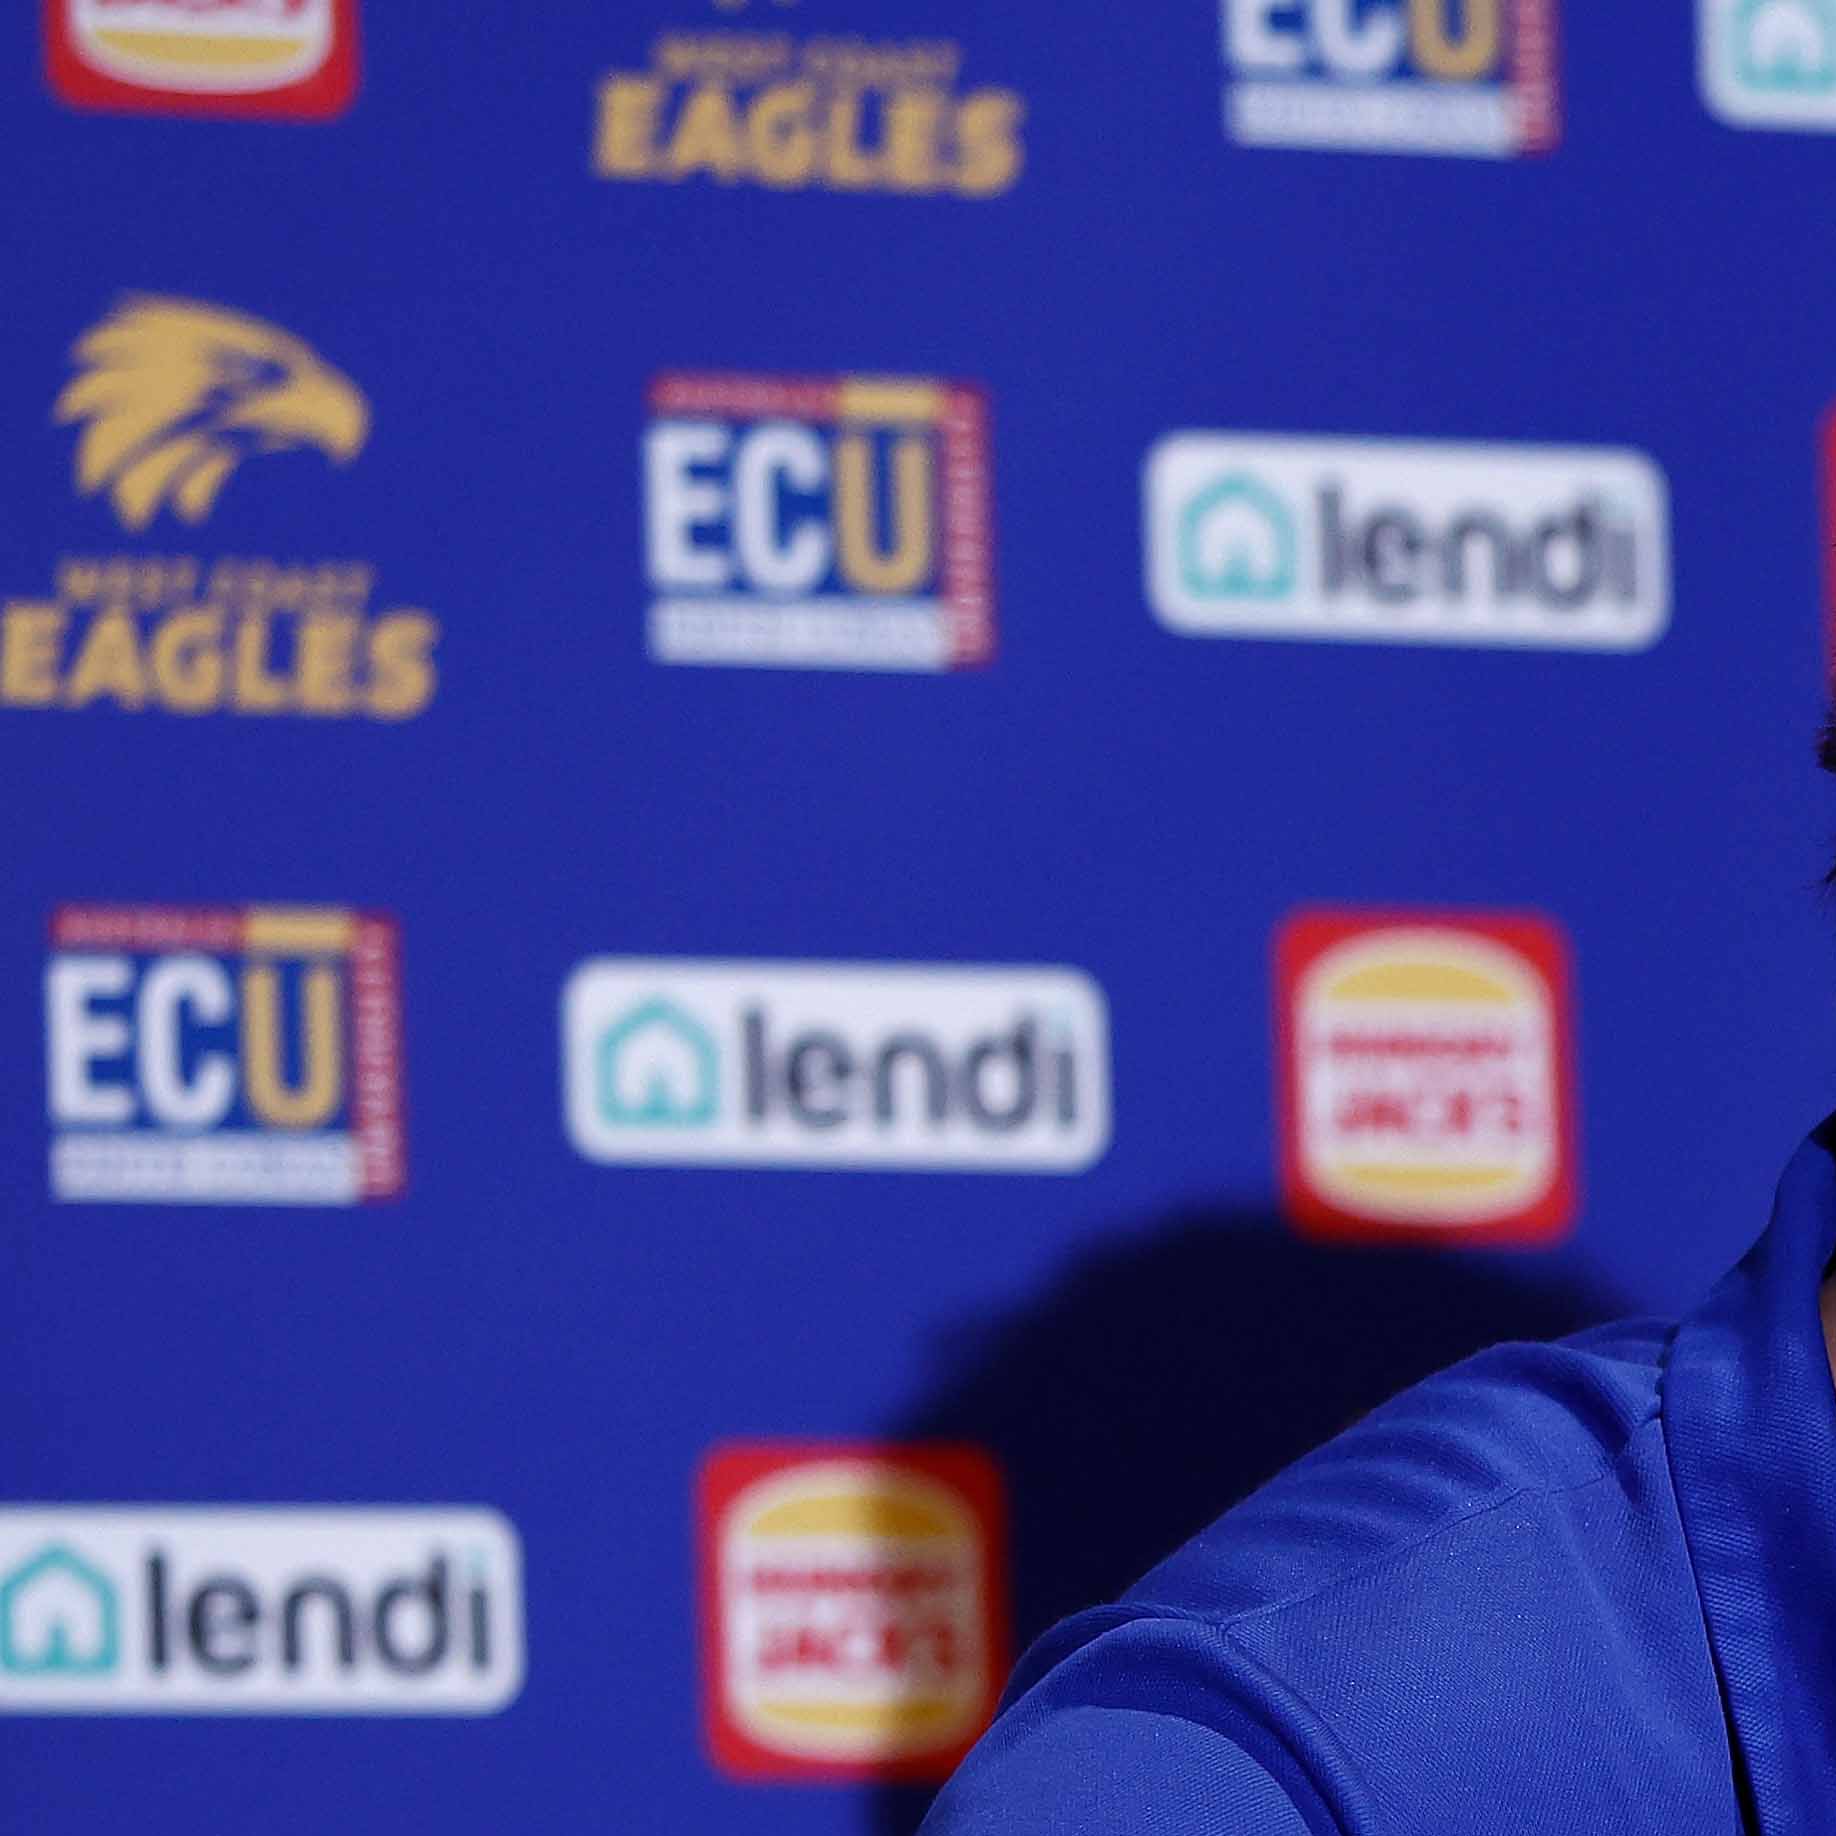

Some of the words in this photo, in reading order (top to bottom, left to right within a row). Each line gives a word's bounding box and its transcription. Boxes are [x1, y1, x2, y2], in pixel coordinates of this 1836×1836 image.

[595, 71, 1023, 196] EAGLES
[643, 418, 932, 592] ECU
[1315, 474, 1639, 613] lendi
[0, 603, 440, 723] EAGLES
[45, 952, 342, 1128] ECU
[741, 1002, 1080, 1135] lendi
[145, 1546, 491, 1676] lendi
